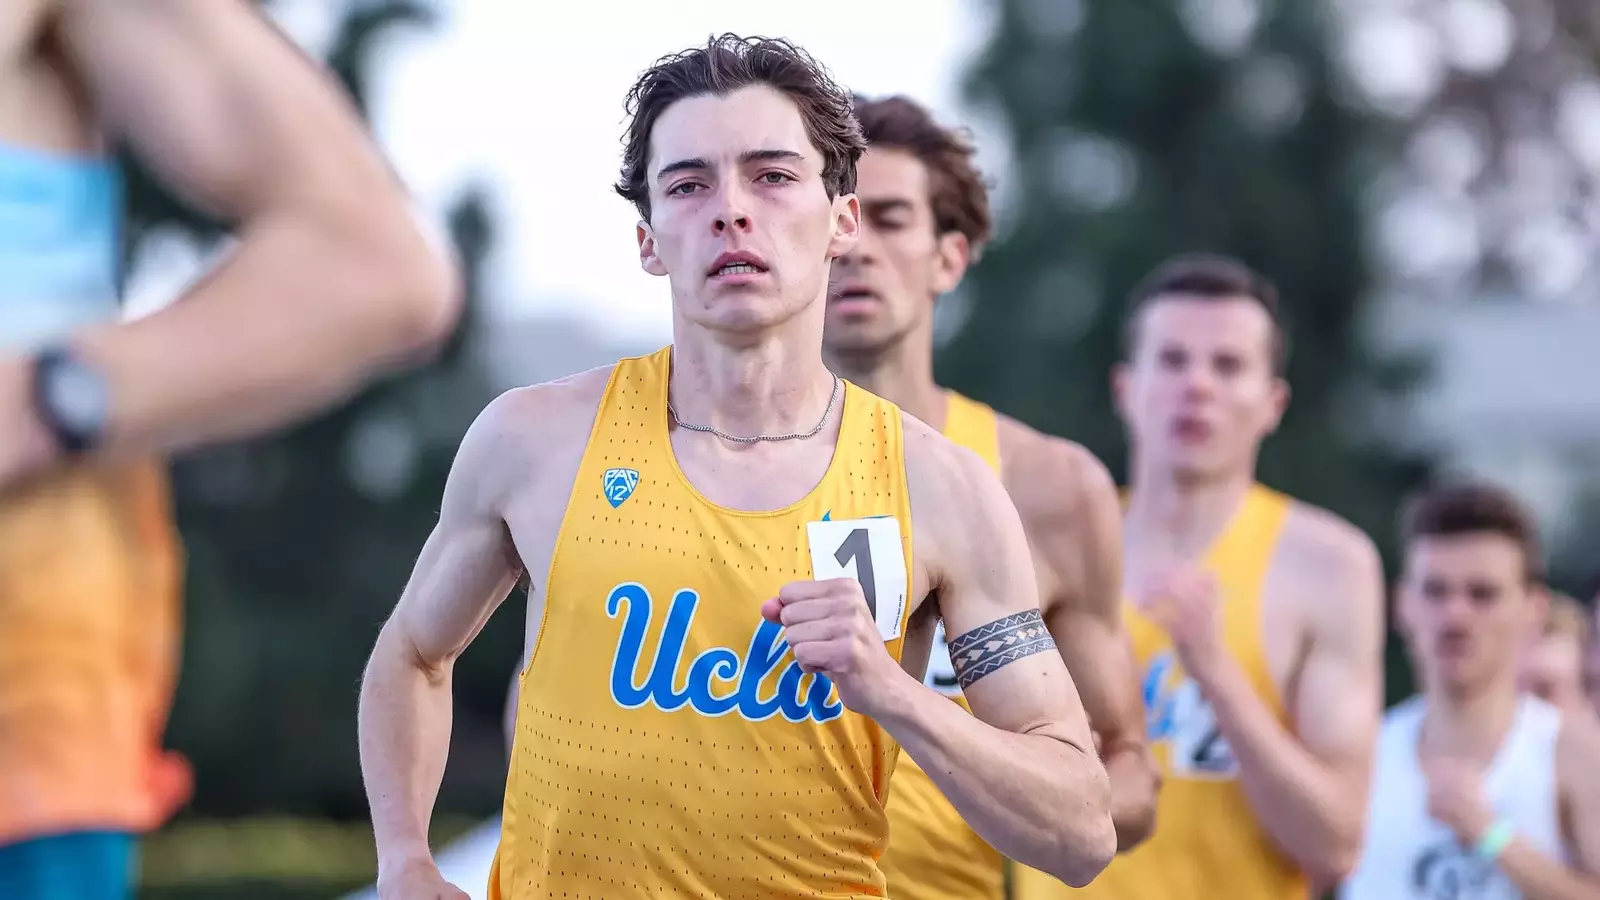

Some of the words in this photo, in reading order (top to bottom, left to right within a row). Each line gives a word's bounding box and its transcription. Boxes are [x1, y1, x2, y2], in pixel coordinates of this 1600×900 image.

[604, 469, 638, 493] PAC
[609, 485, 628, 500] 12
[833, 528, 877, 623] 1
